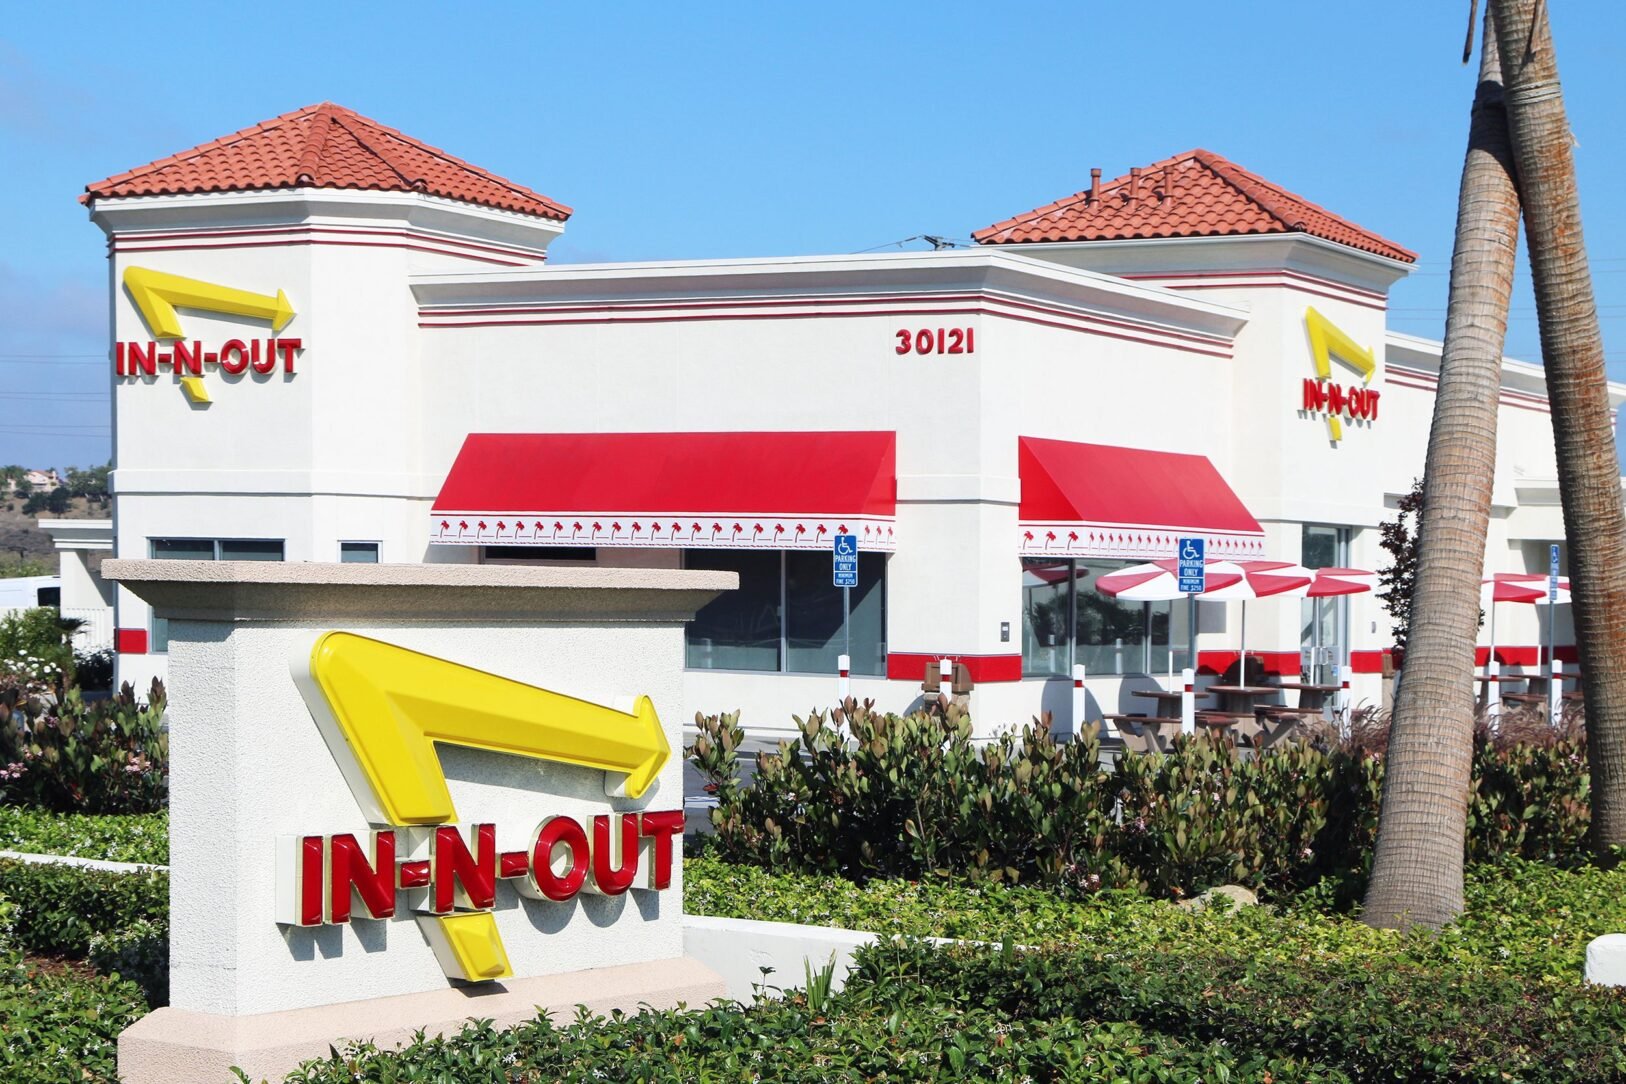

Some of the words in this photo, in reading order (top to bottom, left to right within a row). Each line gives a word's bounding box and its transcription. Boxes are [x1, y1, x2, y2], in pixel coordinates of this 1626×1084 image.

[896, 327, 975, 354] 30121
[116, 337, 302, 377] IN-N-OUT
[1303, 378, 1380, 421] IN-N-OUT
[835, 554, 856, 563] PARKING
[838, 563, 852, 571] ONLY
[1180, 559, 1203, 568] PARKING
[1184, 568, 1198, 577] ONLY
[300, 809, 686, 927] IN-N-OUT
